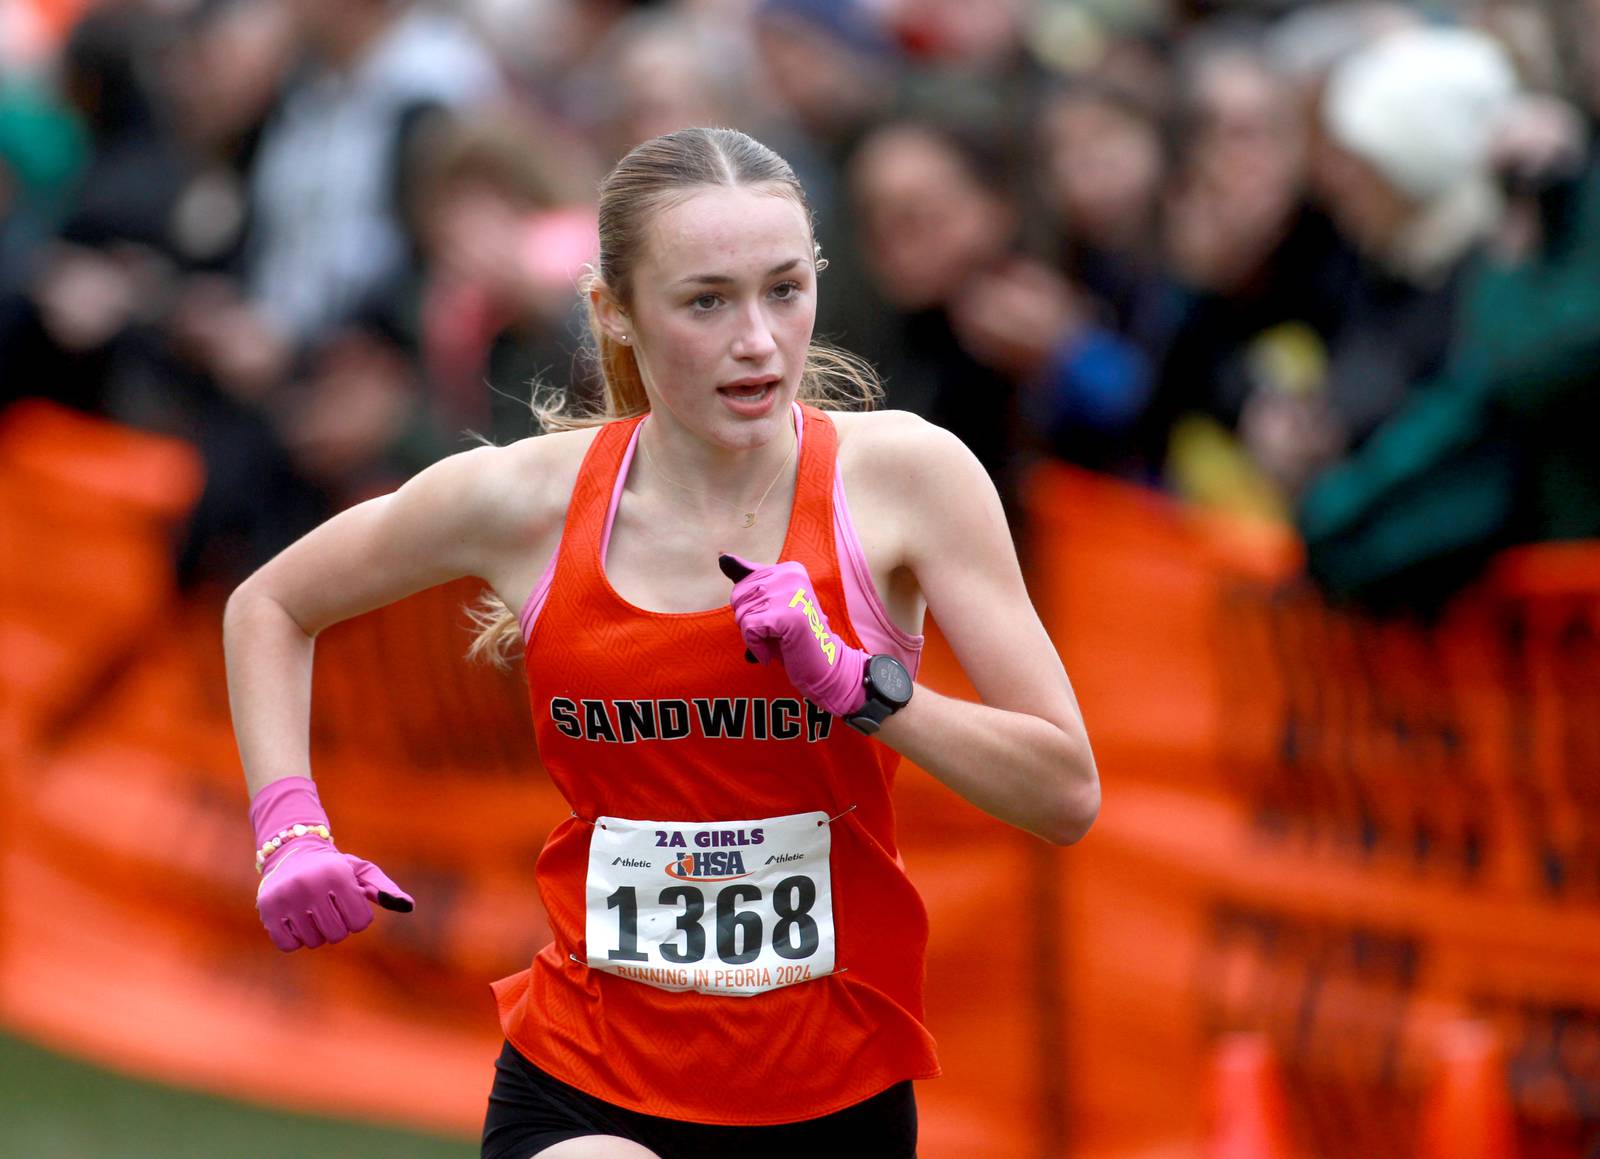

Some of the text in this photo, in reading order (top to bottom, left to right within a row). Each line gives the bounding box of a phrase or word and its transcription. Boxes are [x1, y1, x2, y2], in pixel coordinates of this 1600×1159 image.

[788, 588, 836, 666] HOKA
[550, 696, 833, 743] SANDWICH
[655, 828, 765, 848] 2A GIRLS
[611, 856, 652, 868] Athletic
[765, 852, 804, 865] Athletic
[607, 875, 819, 965] 1368
[617, 964, 812, 988] RUNNING IN PEORIA 2024
